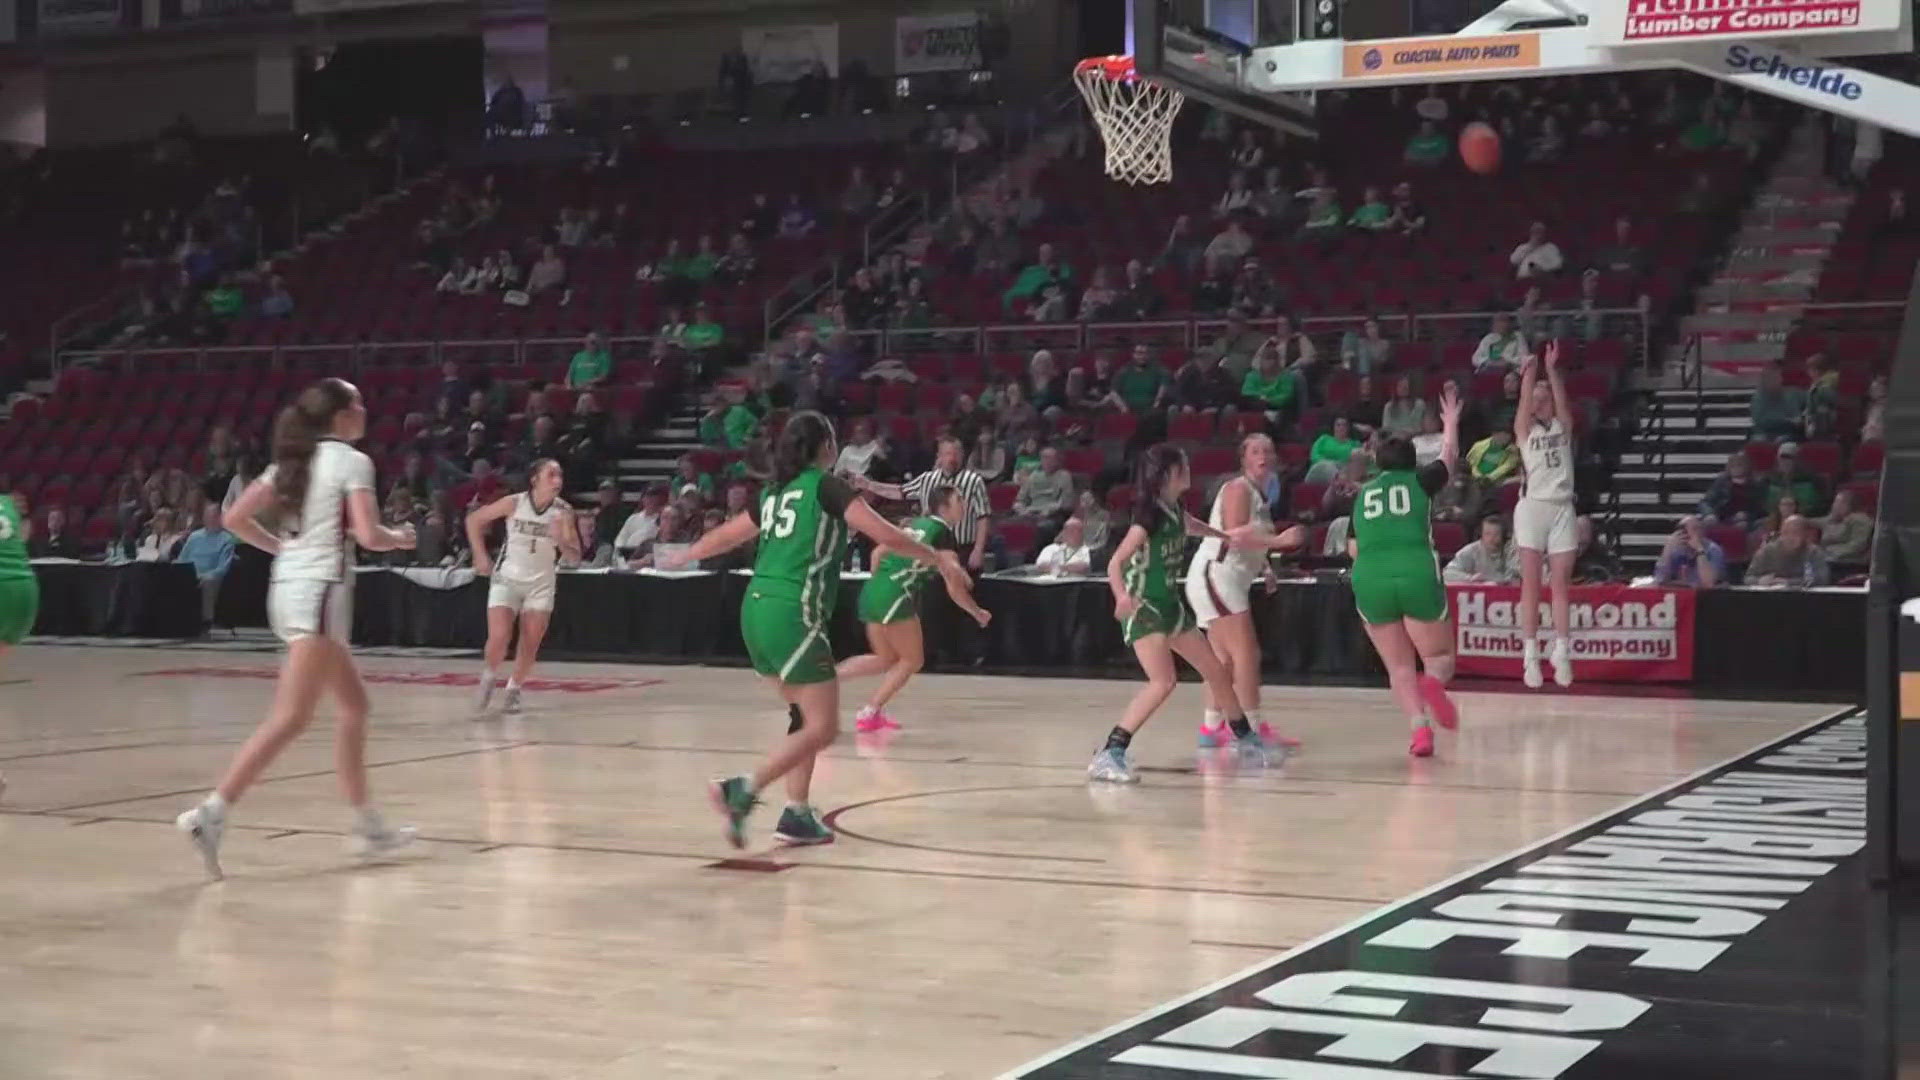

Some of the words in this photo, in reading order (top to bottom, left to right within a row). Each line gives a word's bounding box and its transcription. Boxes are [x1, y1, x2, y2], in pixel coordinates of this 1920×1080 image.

[1626, 14, 1723, 36] Lumber
[1728, 7, 1857, 29] Company
[1393, 48, 1443, 65] COASTAL
[1445, 46, 1481, 61] AUTO
[1481, 44, 1521, 59] PARTS
[1725, 45, 1862, 100] Schelde
[1544, 450, 1561, 469] 15
[761, 489, 804, 540] 45
[1363, 484, 1411, 520] 50
[1462, 630, 1548, 652] Lumbr
[1570, 637, 1672, 658] ompany
[1364, 771, 1867, 971] INSURANCE
